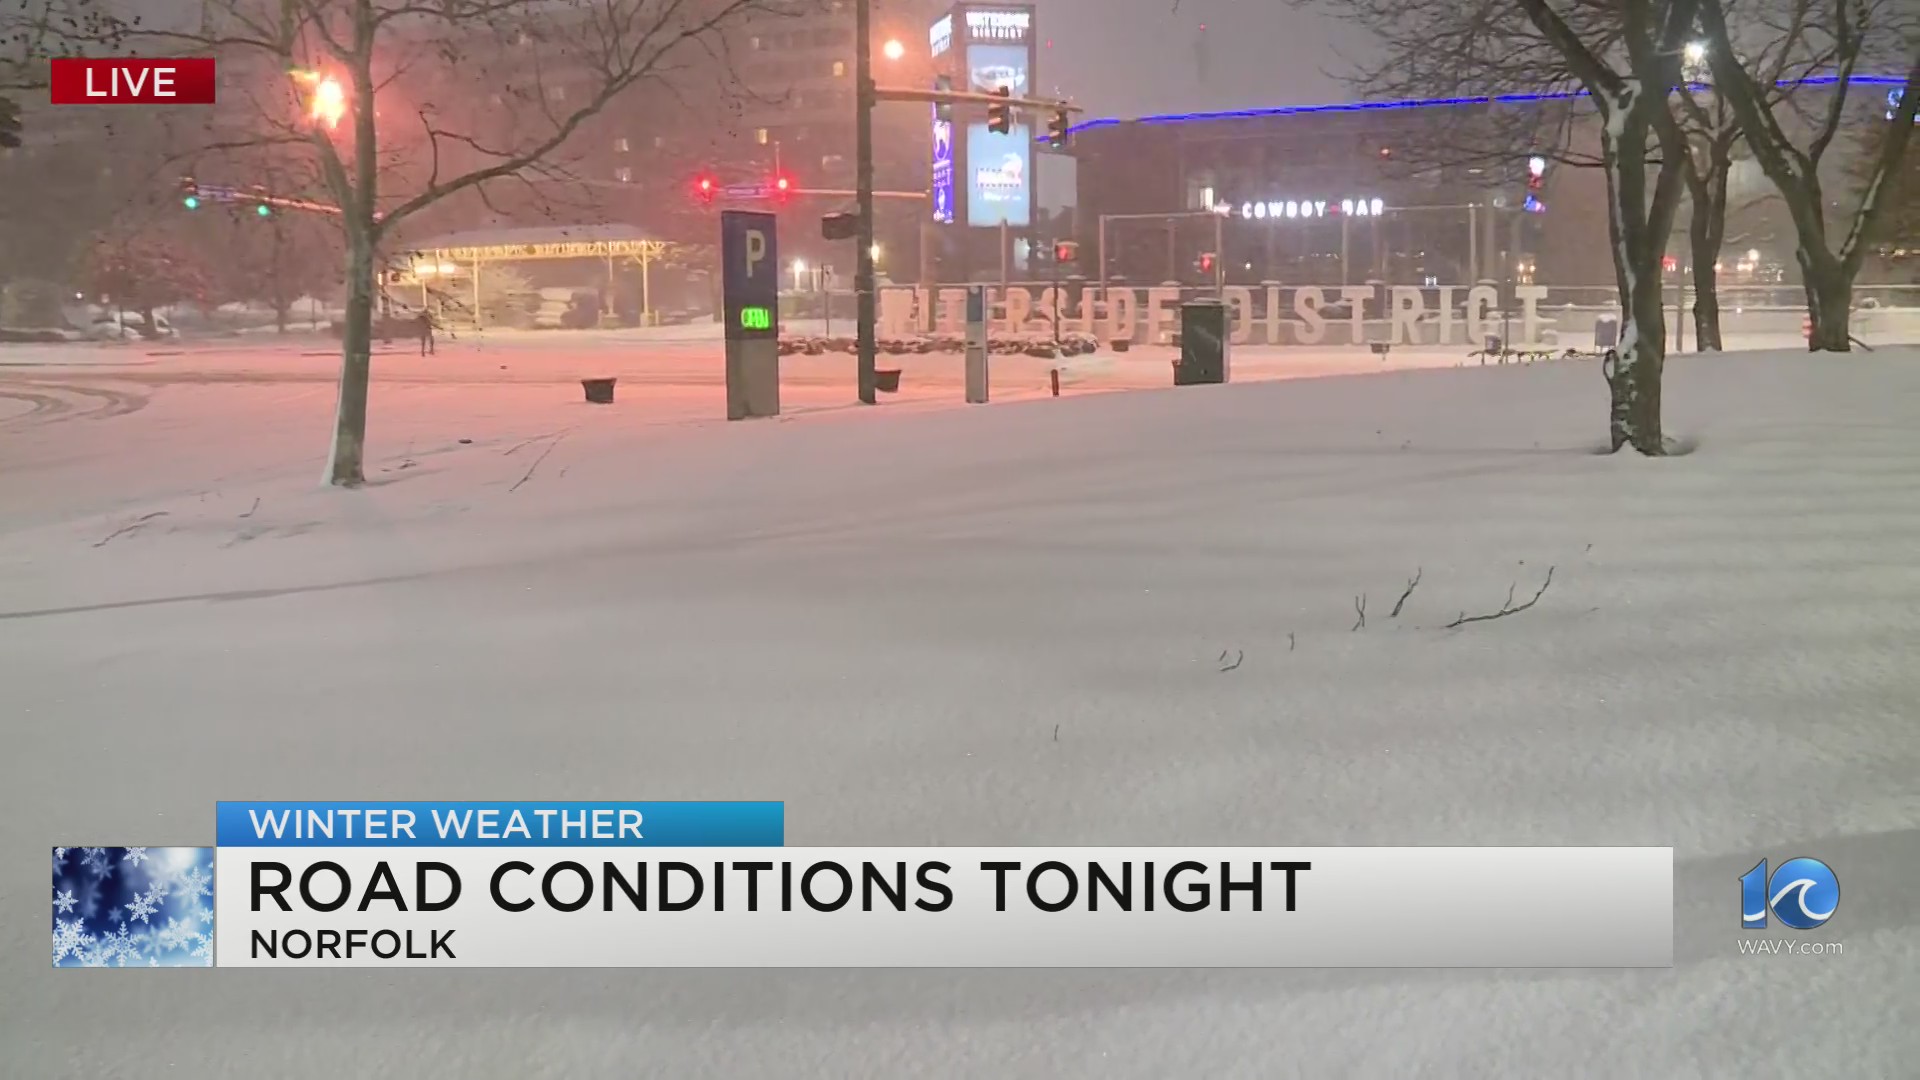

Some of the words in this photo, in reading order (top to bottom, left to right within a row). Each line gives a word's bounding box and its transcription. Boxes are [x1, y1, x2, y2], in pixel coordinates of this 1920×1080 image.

[1242, 200, 1327, 219] COWBOY
[1342, 197, 1384, 217] BAR
[746, 229, 766, 278] P
[1222, 284, 1549, 345] DISTRICT
